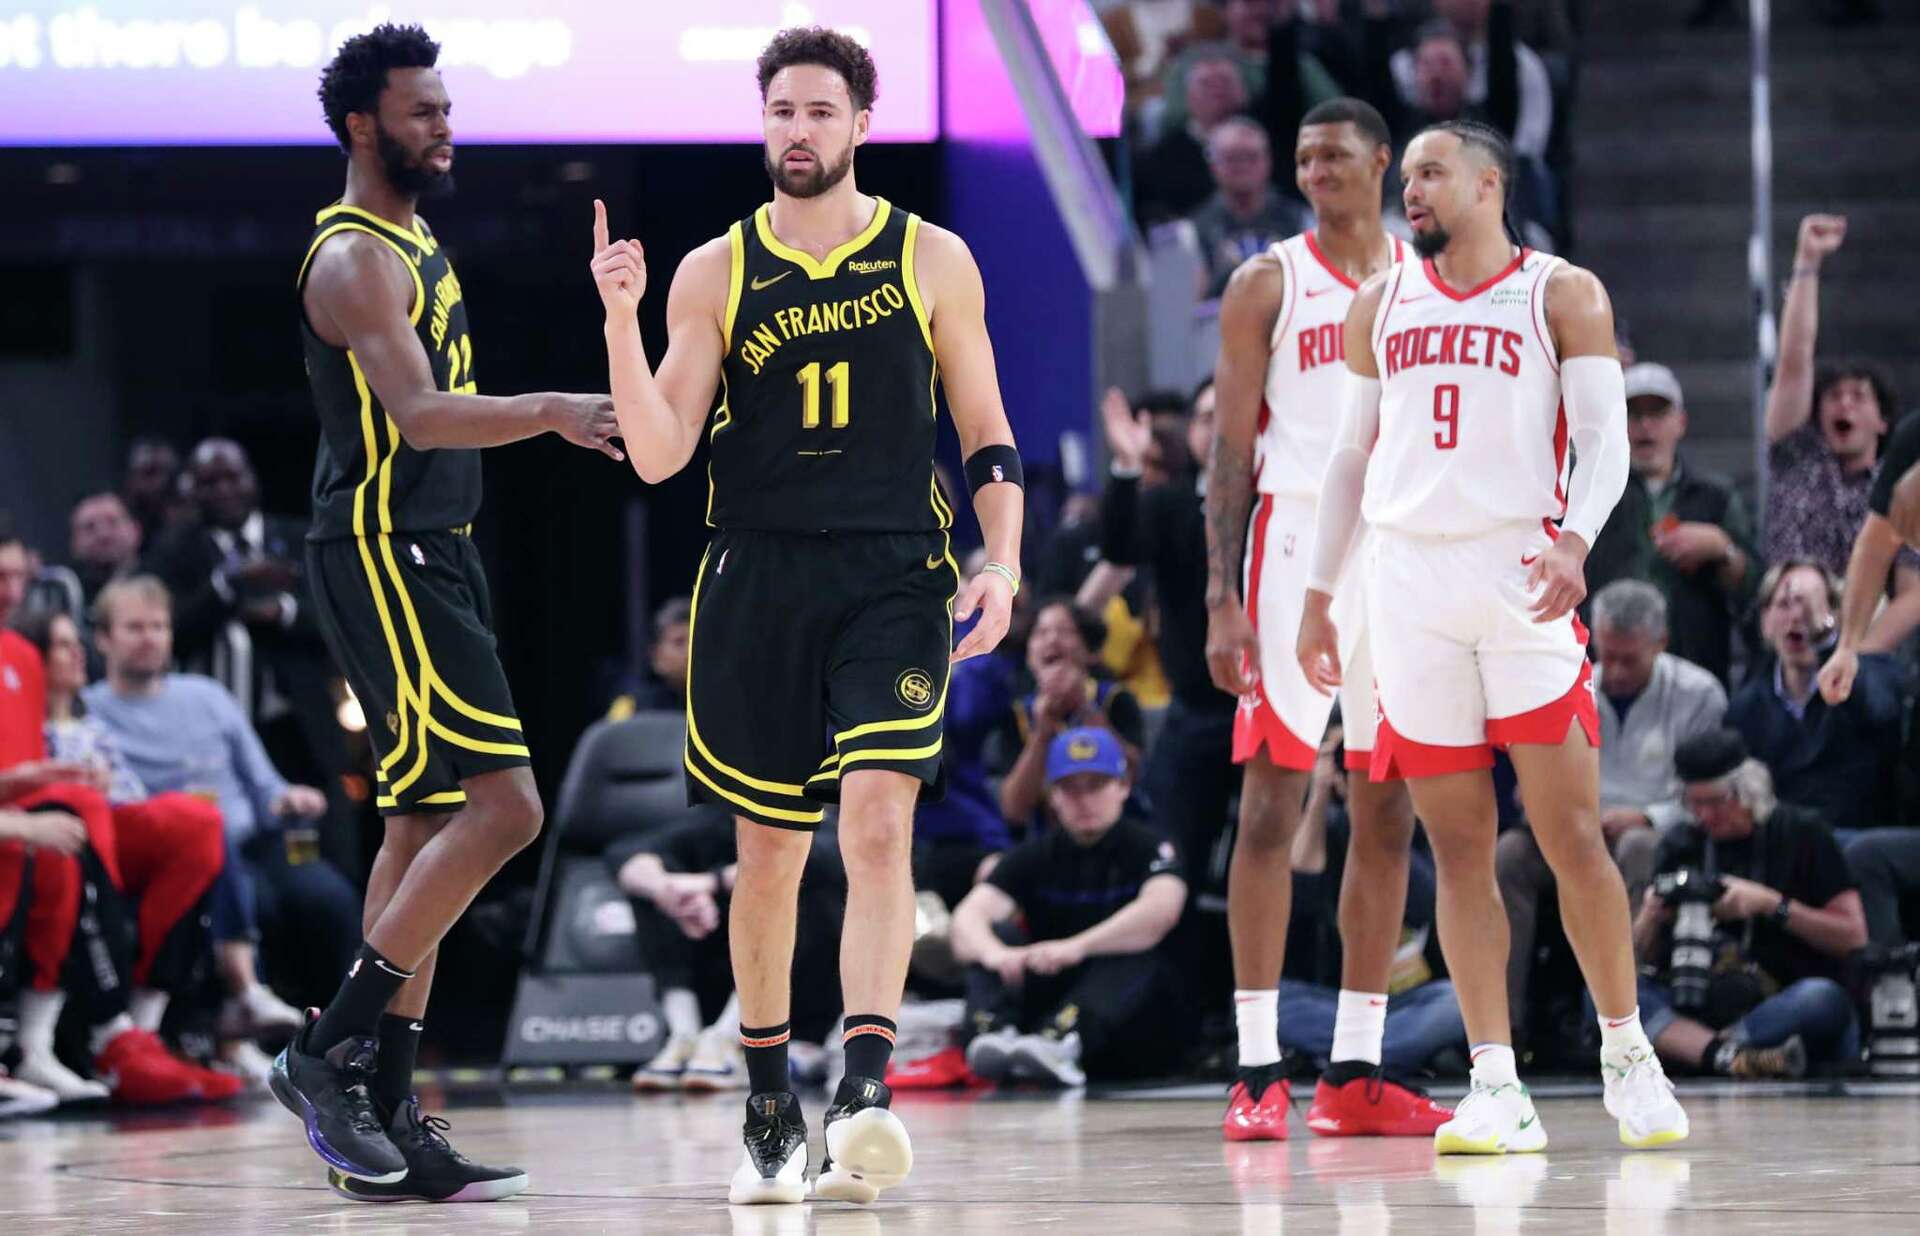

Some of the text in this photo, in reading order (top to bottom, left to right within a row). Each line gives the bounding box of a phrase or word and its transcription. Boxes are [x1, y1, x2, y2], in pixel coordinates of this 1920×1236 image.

[52, 6, 227, 67] there
[848, 260, 896, 272] Rakuten
[742, 282, 904, 375] SAN FRANCISCO
[1386, 325, 1523, 379] ROCKETS
[796, 362, 849, 429] 11
[1433, 384, 1460, 450] 9
[521, 1015, 626, 1043] CHASE
